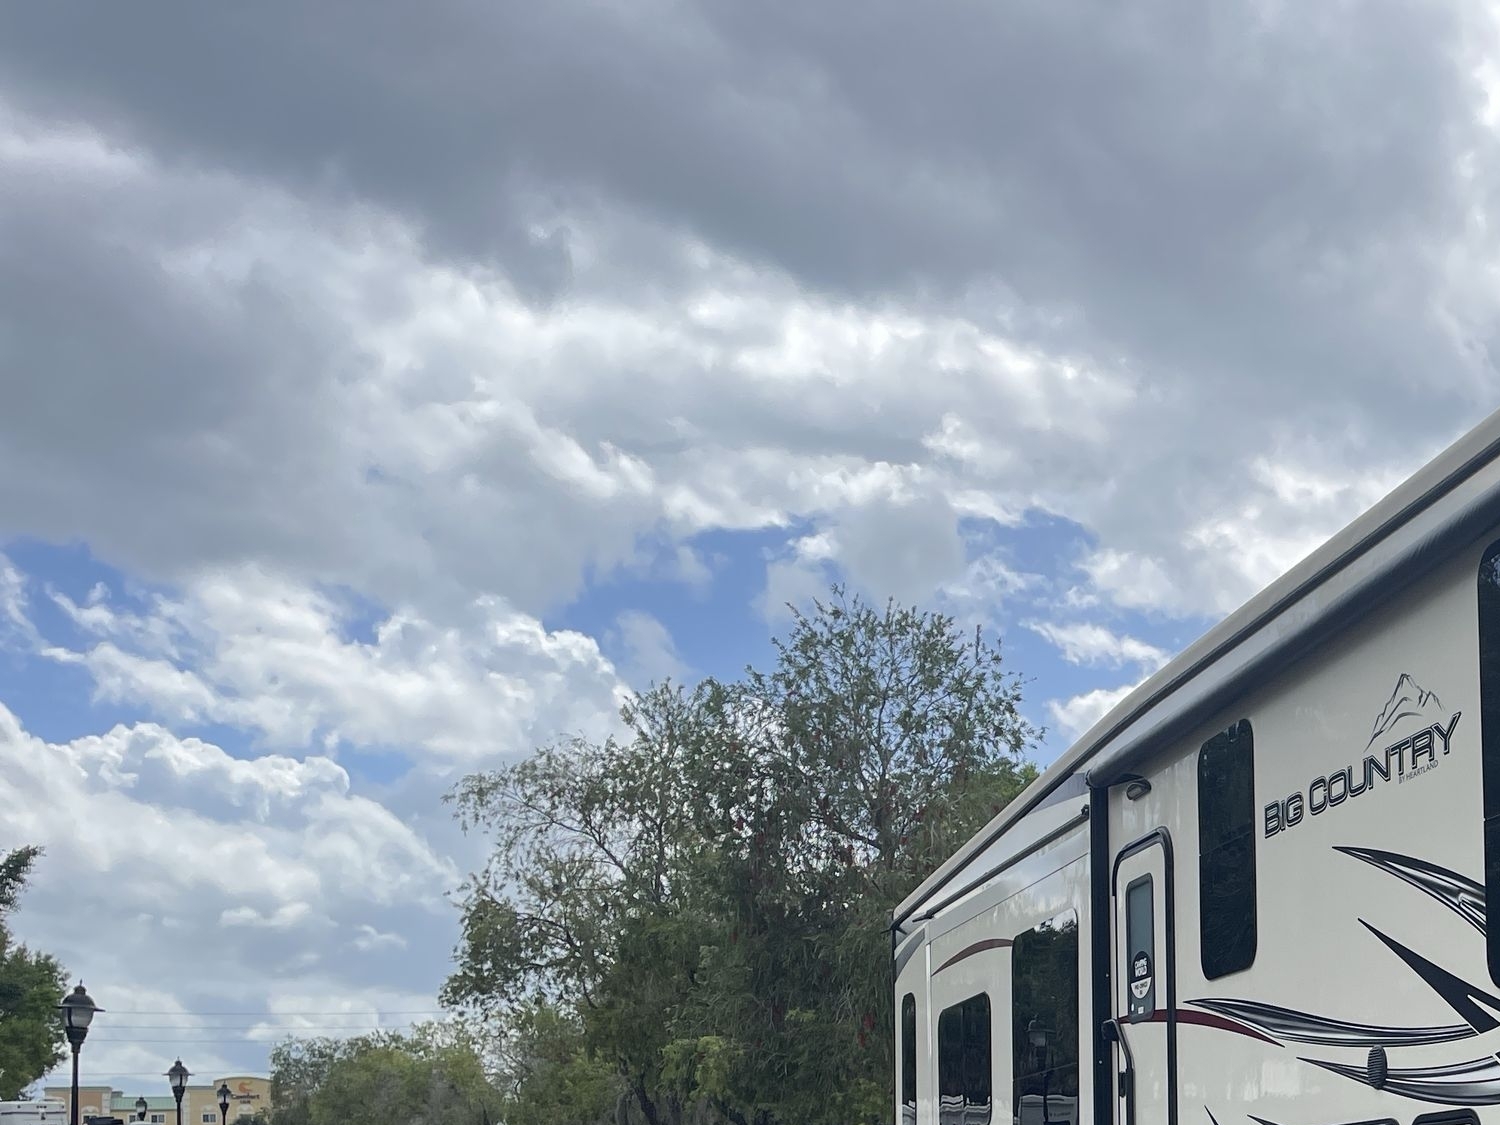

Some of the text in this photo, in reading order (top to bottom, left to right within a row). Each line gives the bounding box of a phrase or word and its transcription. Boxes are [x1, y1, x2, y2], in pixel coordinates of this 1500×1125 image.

[1264, 711, 1462, 839] BIG COUNTRY
[1399, 759, 1439, 785] BY HEARTLAND
